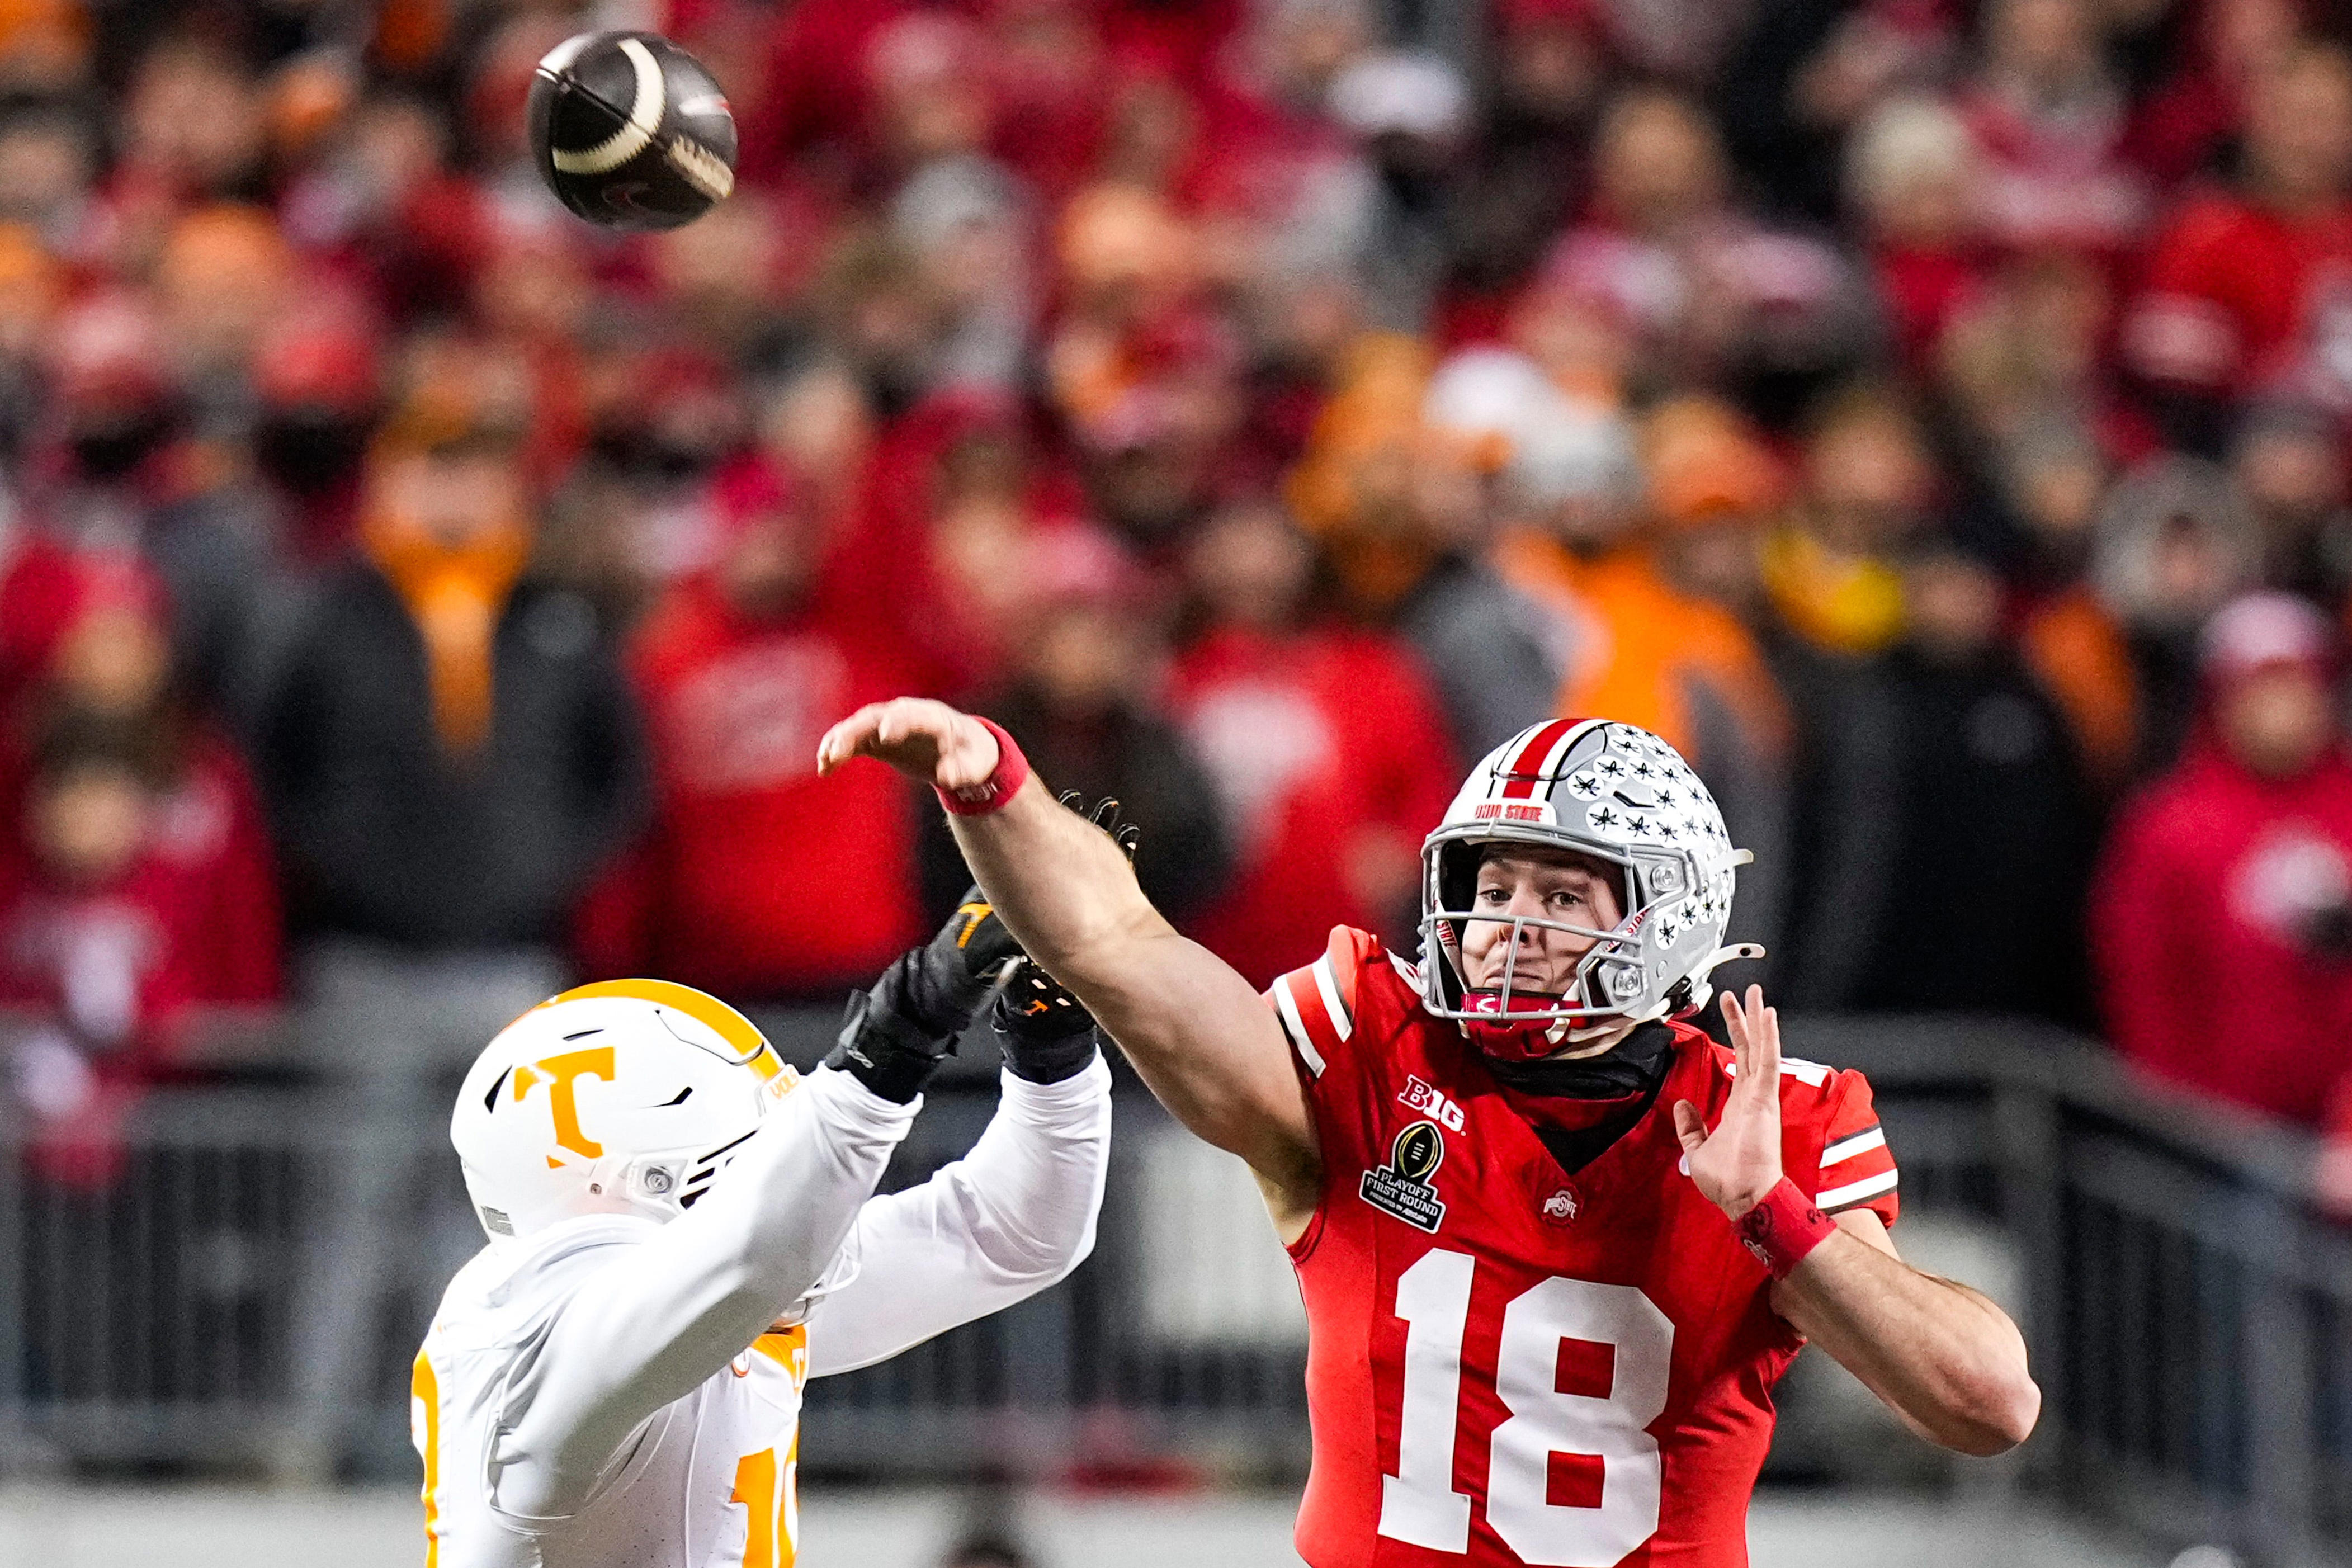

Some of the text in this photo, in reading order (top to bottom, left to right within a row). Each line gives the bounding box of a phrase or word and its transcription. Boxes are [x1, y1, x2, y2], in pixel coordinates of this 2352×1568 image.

[1475, 804, 1543, 822] OHIO STATE
[514, 1046, 615, 1169] T
[1366, 1177, 1439, 1217] FIRST ROUND
[1380, 1172, 1431, 1200] PLAYOFF
[1377, 1247, 1675, 1568] 18
